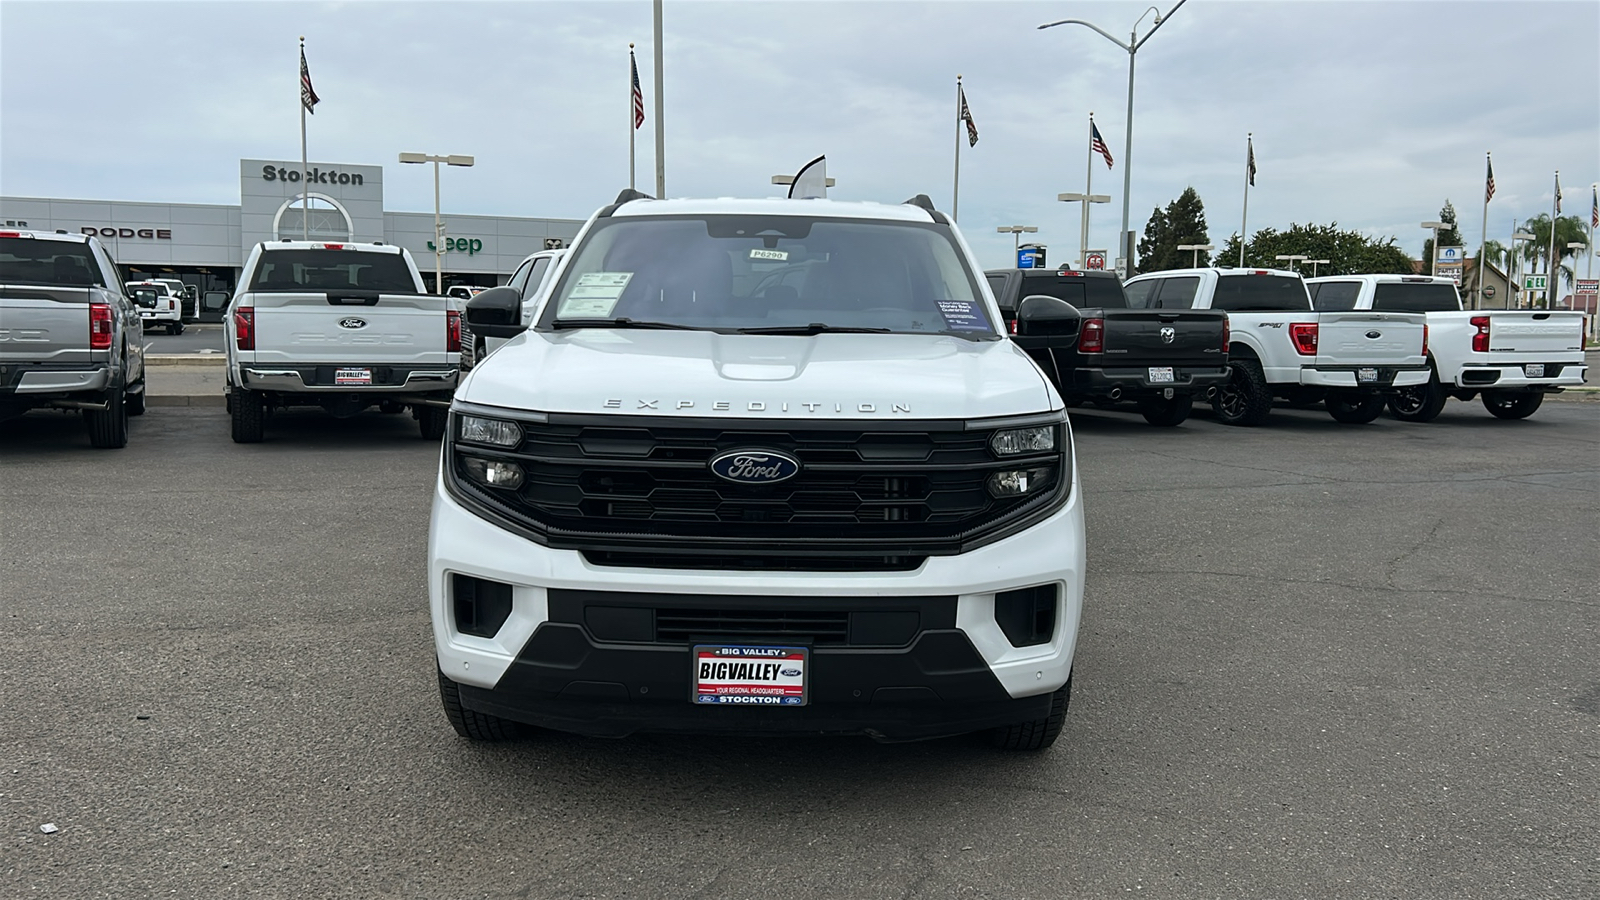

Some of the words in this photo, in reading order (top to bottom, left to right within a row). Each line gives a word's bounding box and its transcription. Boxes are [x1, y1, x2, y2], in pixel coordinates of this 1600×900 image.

[262, 165, 363, 186] Stockton
[0, 220, 28, 228] ER
[81, 226, 172, 240] DODGE
[754, 251, 783, 259] P6290
[602, 398, 911, 414] EXPEDITION
[727, 454, 783, 479] Ford
[721, 648, 740, 656] BIG
[743, 648, 781, 656] VALLEY
[699, 662, 782, 681] BIGVALLEY
[719, 696, 781, 704] STOCKTON
